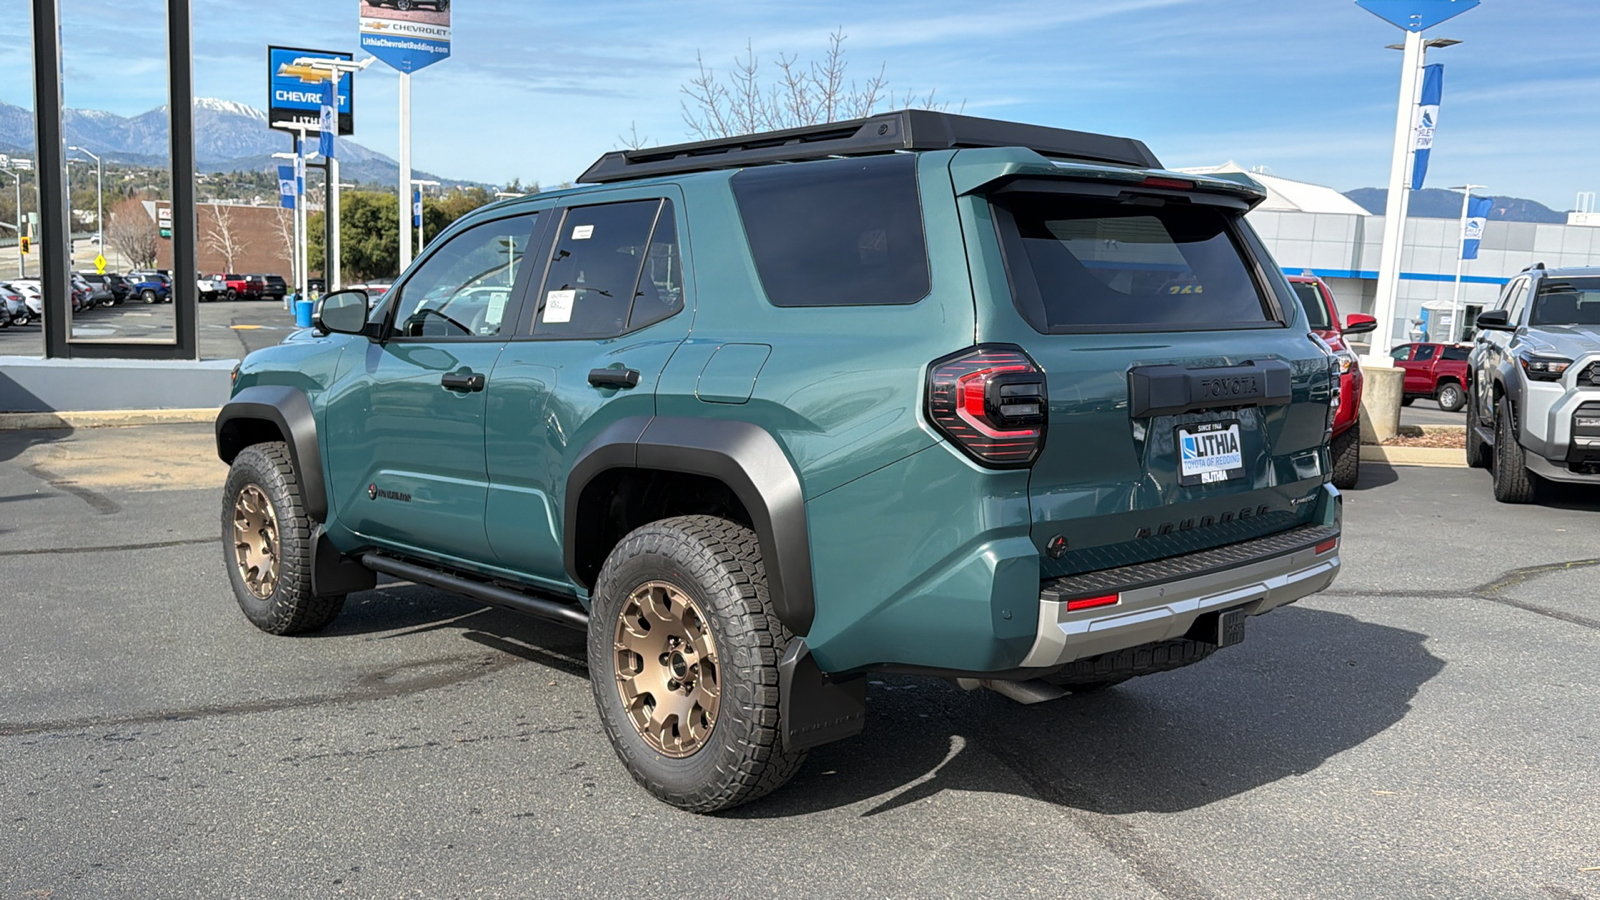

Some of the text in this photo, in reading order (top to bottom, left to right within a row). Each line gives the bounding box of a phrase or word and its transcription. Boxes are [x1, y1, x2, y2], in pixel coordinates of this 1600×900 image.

[392, 23, 447, 36] CHEVROLET
[362, 37, 448, 53] LithiaChevroletRedding.com
[1201, 376, 1258, 398] TOYOTA
[1194, 432, 1239, 457] LITHIA
[1183, 454, 1240, 470] TOYOTA OF REDDING
